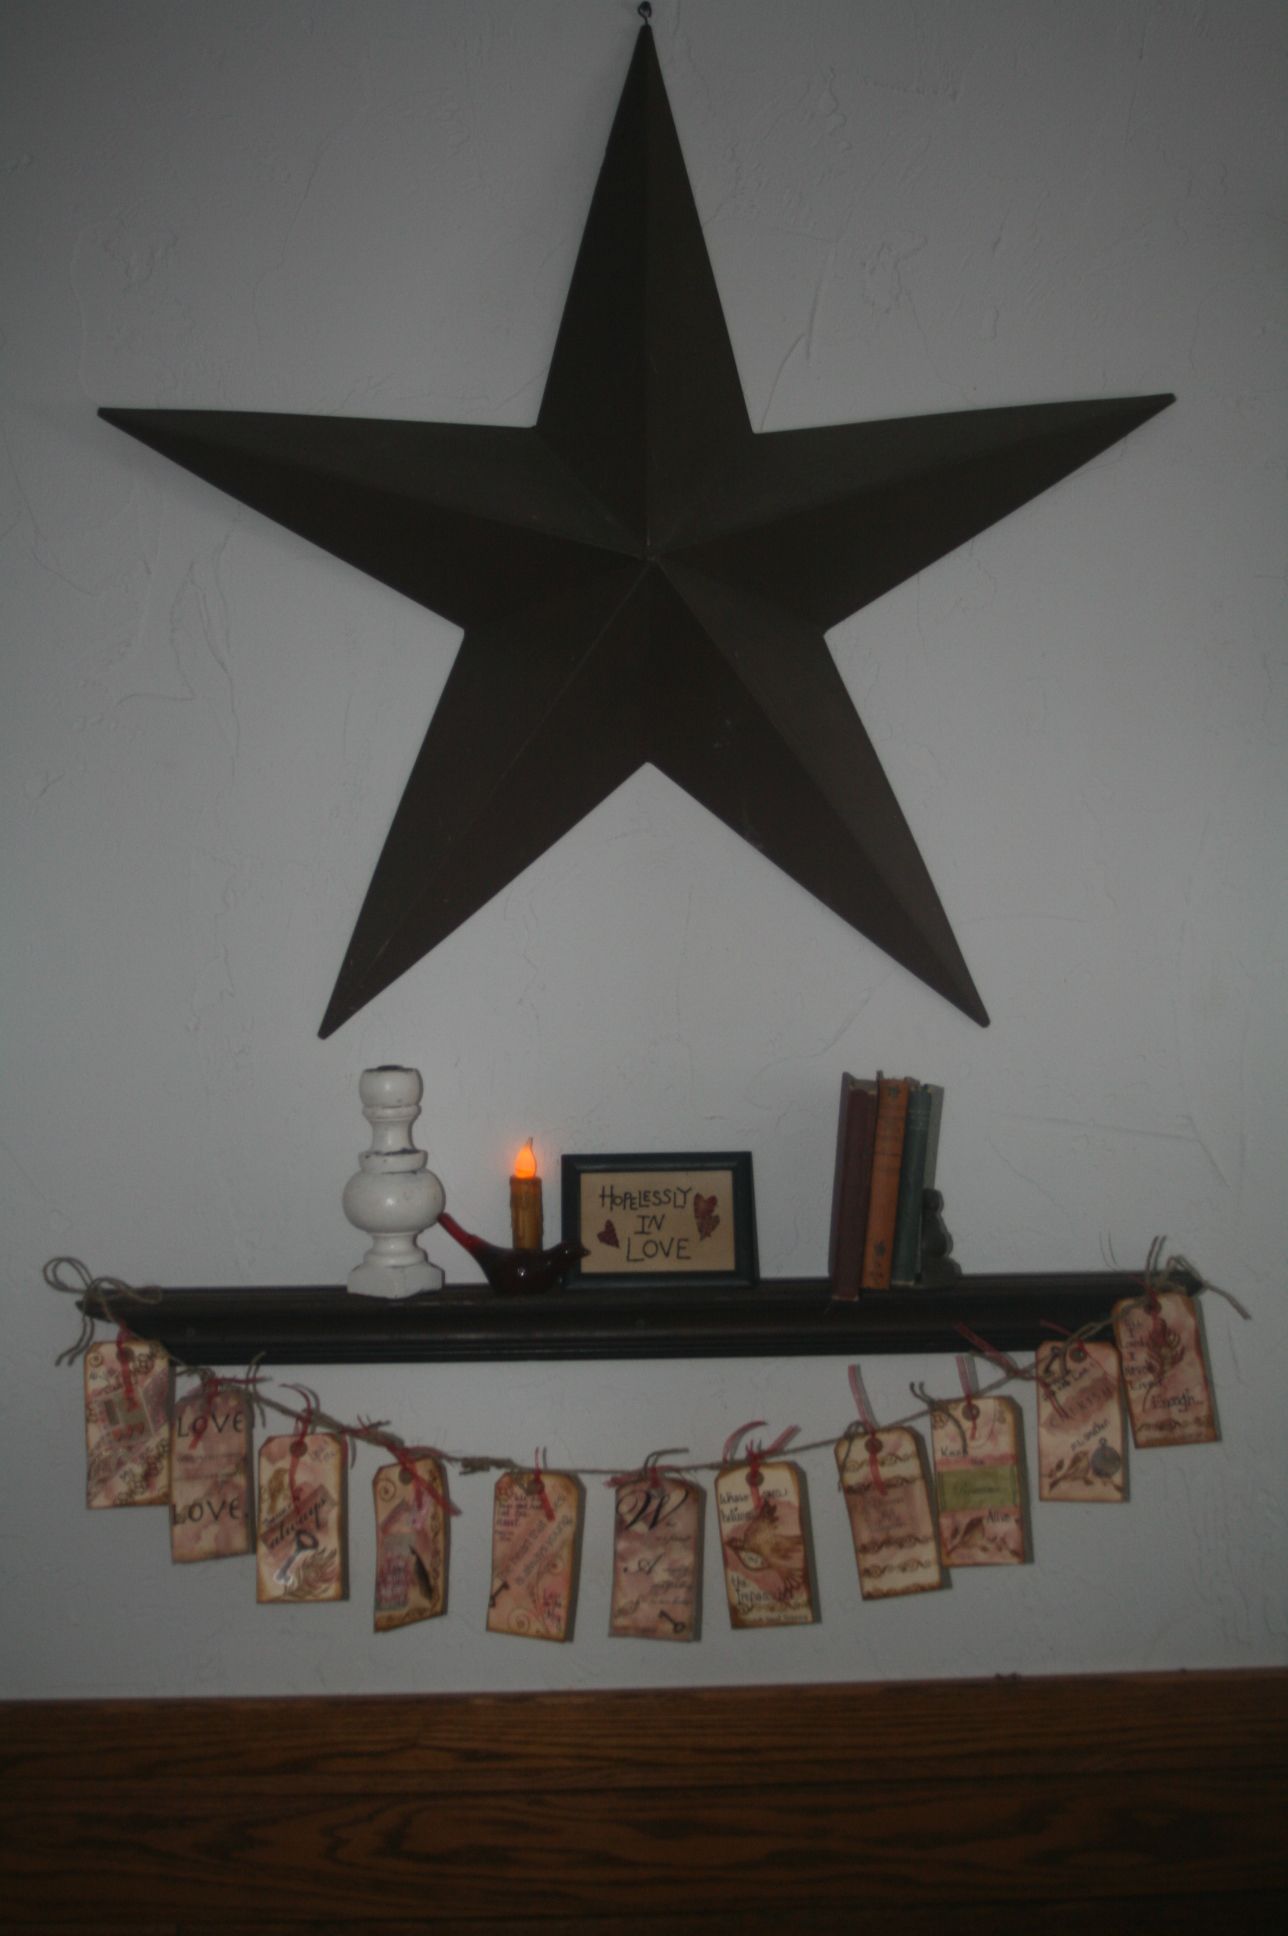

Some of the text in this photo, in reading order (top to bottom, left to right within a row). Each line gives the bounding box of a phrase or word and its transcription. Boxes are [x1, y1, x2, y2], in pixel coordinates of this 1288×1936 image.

[599, 1184, 693, 1212] HOPELESSLY
[634, 1213, 666, 1235] IN
[626, 1236, 692, 1263] LOVE
[177, 1410, 243, 1438] LOVE
